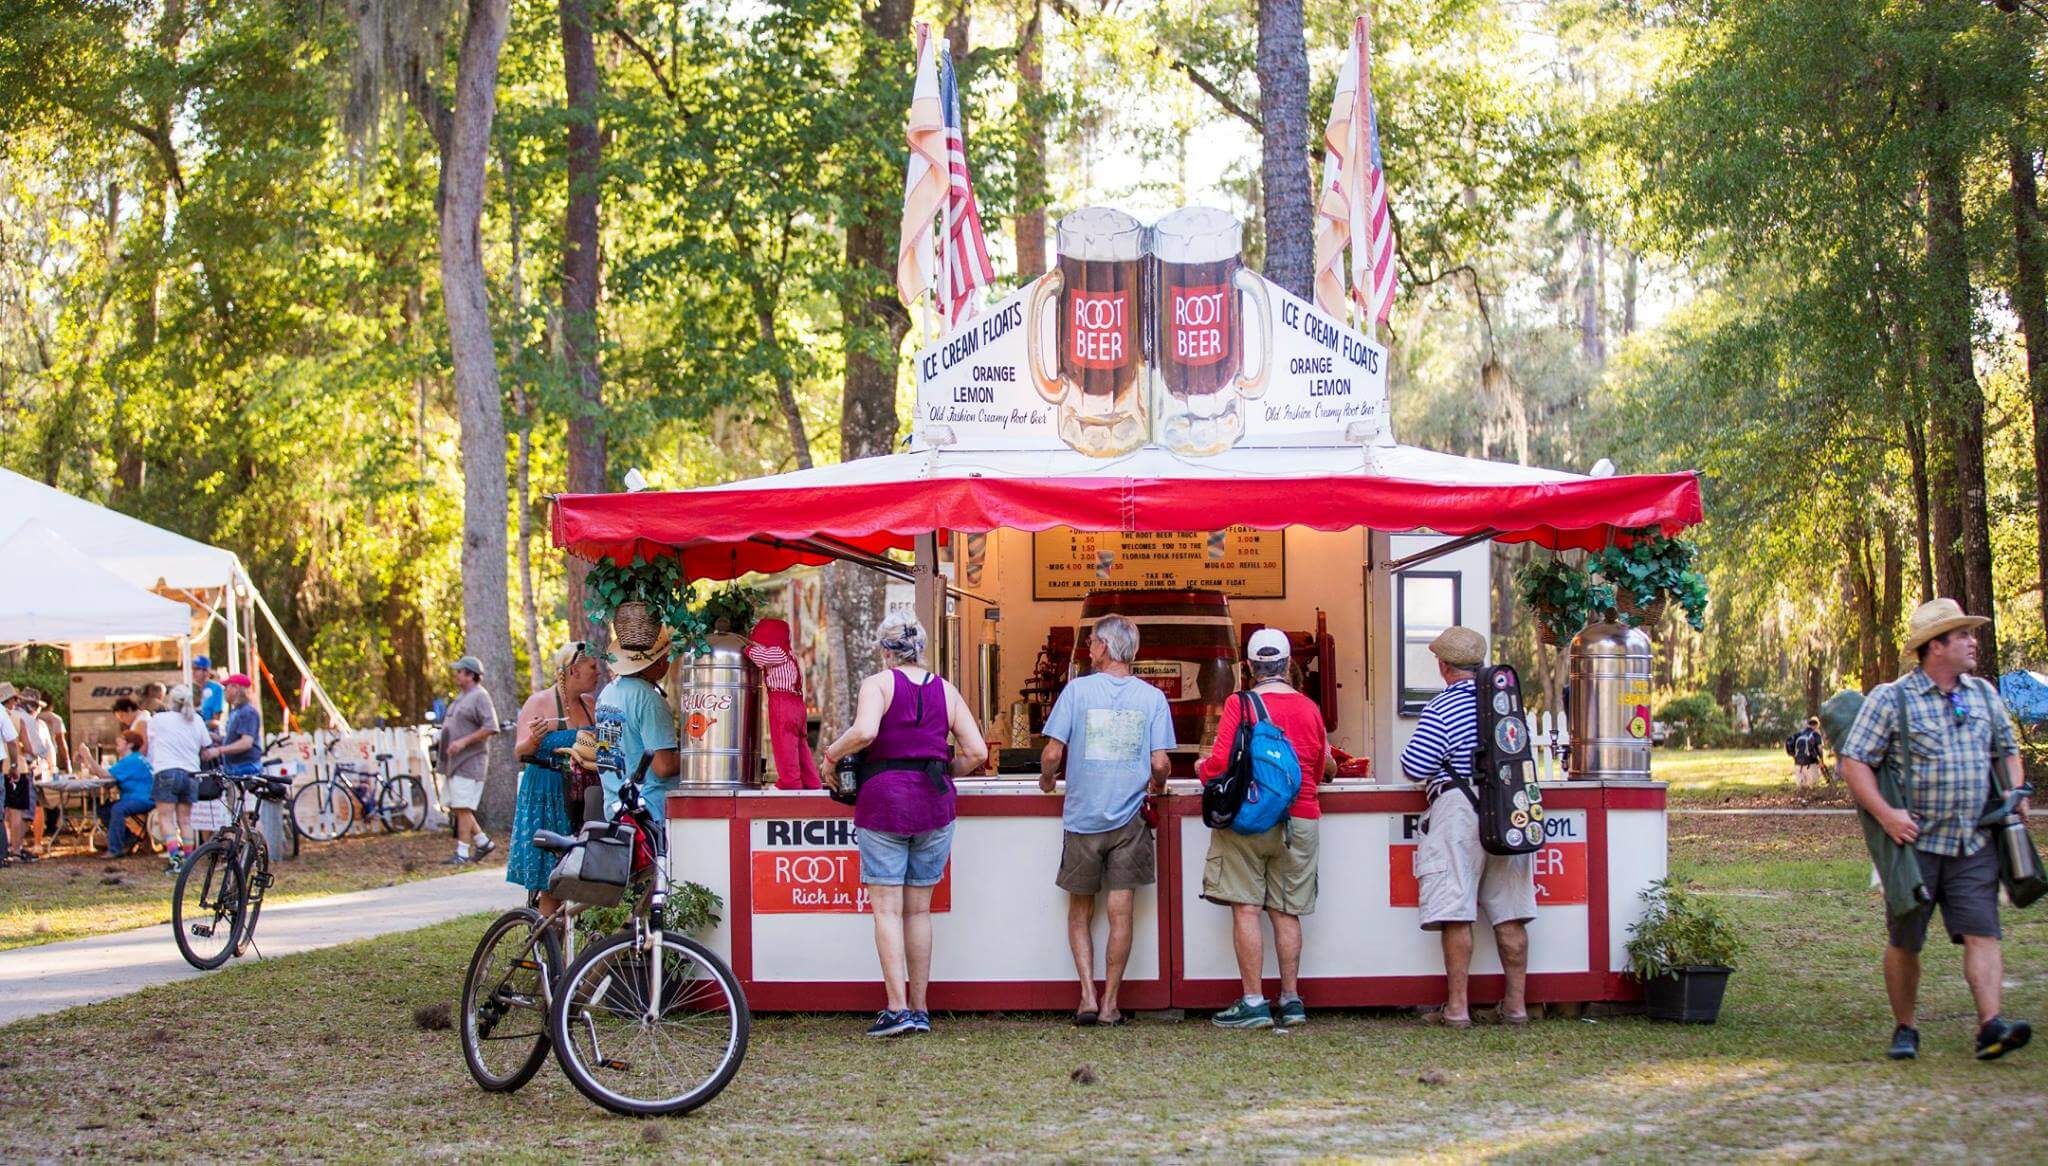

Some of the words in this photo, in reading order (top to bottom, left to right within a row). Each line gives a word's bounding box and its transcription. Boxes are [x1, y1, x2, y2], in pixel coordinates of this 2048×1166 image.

[1075, 298, 1124, 329] ROOT
[1176, 293, 1223, 325] ROOT
[922, 352, 938, 383] ICE
[941, 327, 979, 370] CREAM
[982, 301, 1022, 346] FLOATS
[1076, 330, 1122, 360] BEER
[1178, 329, 1221, 357] BEER
[1282, 299, 1299, 330] ICE
[1304, 312, 1339, 353] CREAM
[1343, 335, 1379, 374] FLOATS
[972, 365, 1016, 382] ORANGE
[1290, 357, 1332, 375] ORANGE
[953, 387, 994, 403] LEMON
[1310, 378, 1351, 397] LEMON
[947, 406, 975, 422] Fashion
[978, 408, 1009, 430] Creamy
[1010, 408, 1028, 424] Root
[91, 686, 134, 697] BUD
[775, 856, 848, 884] ROOT
[792, 888, 828, 904] Rich
[833, 890, 853, 904] in
